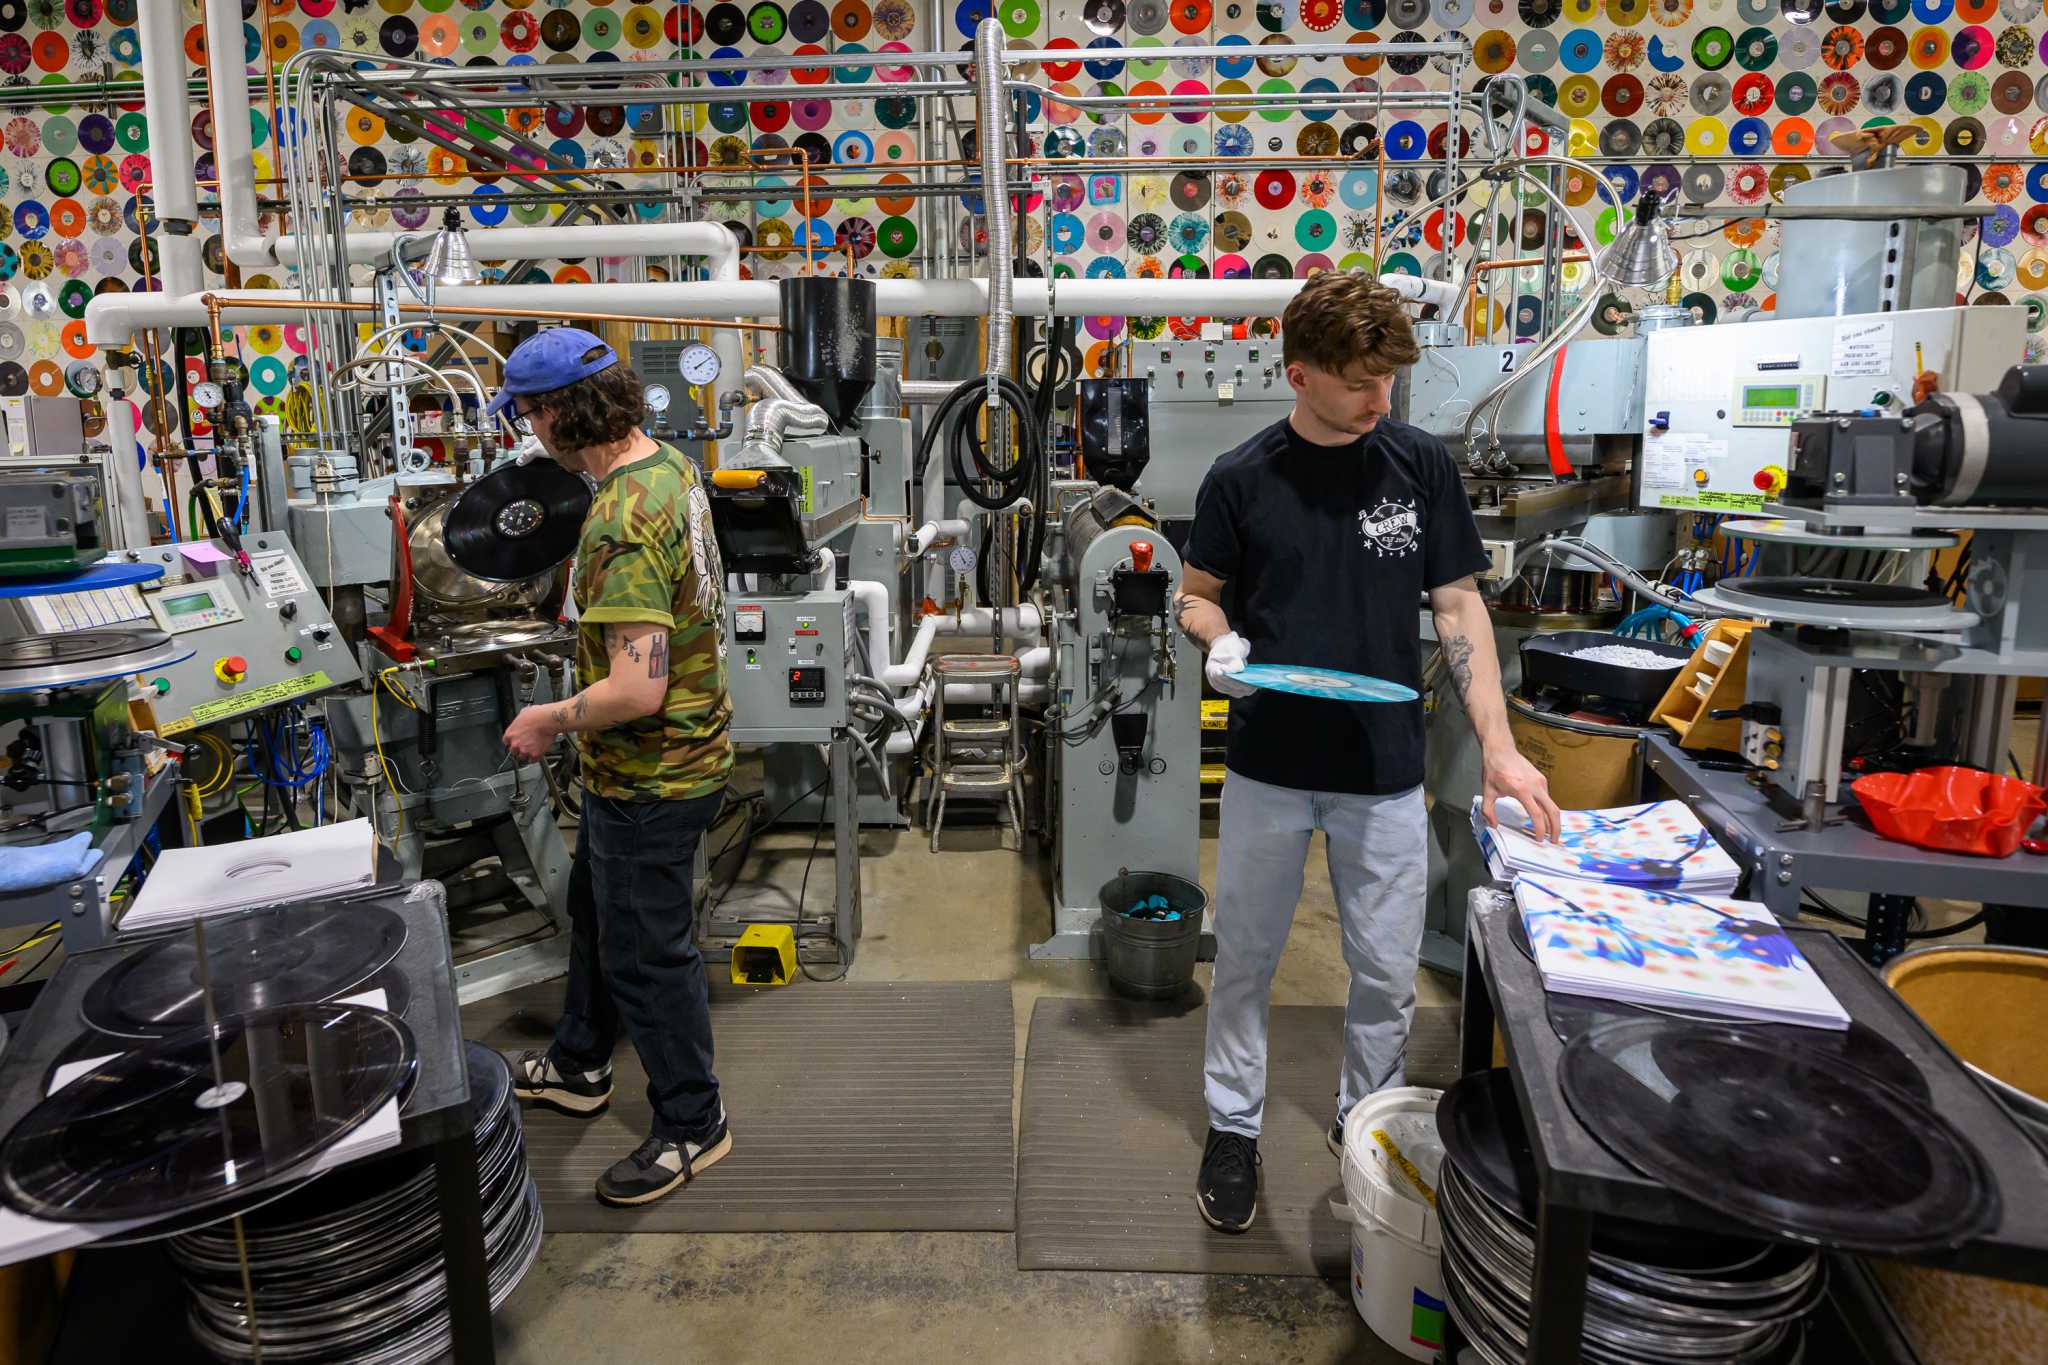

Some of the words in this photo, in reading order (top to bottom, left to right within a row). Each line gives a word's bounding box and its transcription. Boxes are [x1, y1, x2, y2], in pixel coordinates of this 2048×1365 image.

[1501, 350, 1514, 373] 2
[1375, 513, 1409, 534] CREW
[793, 671, 801, 681] 2
